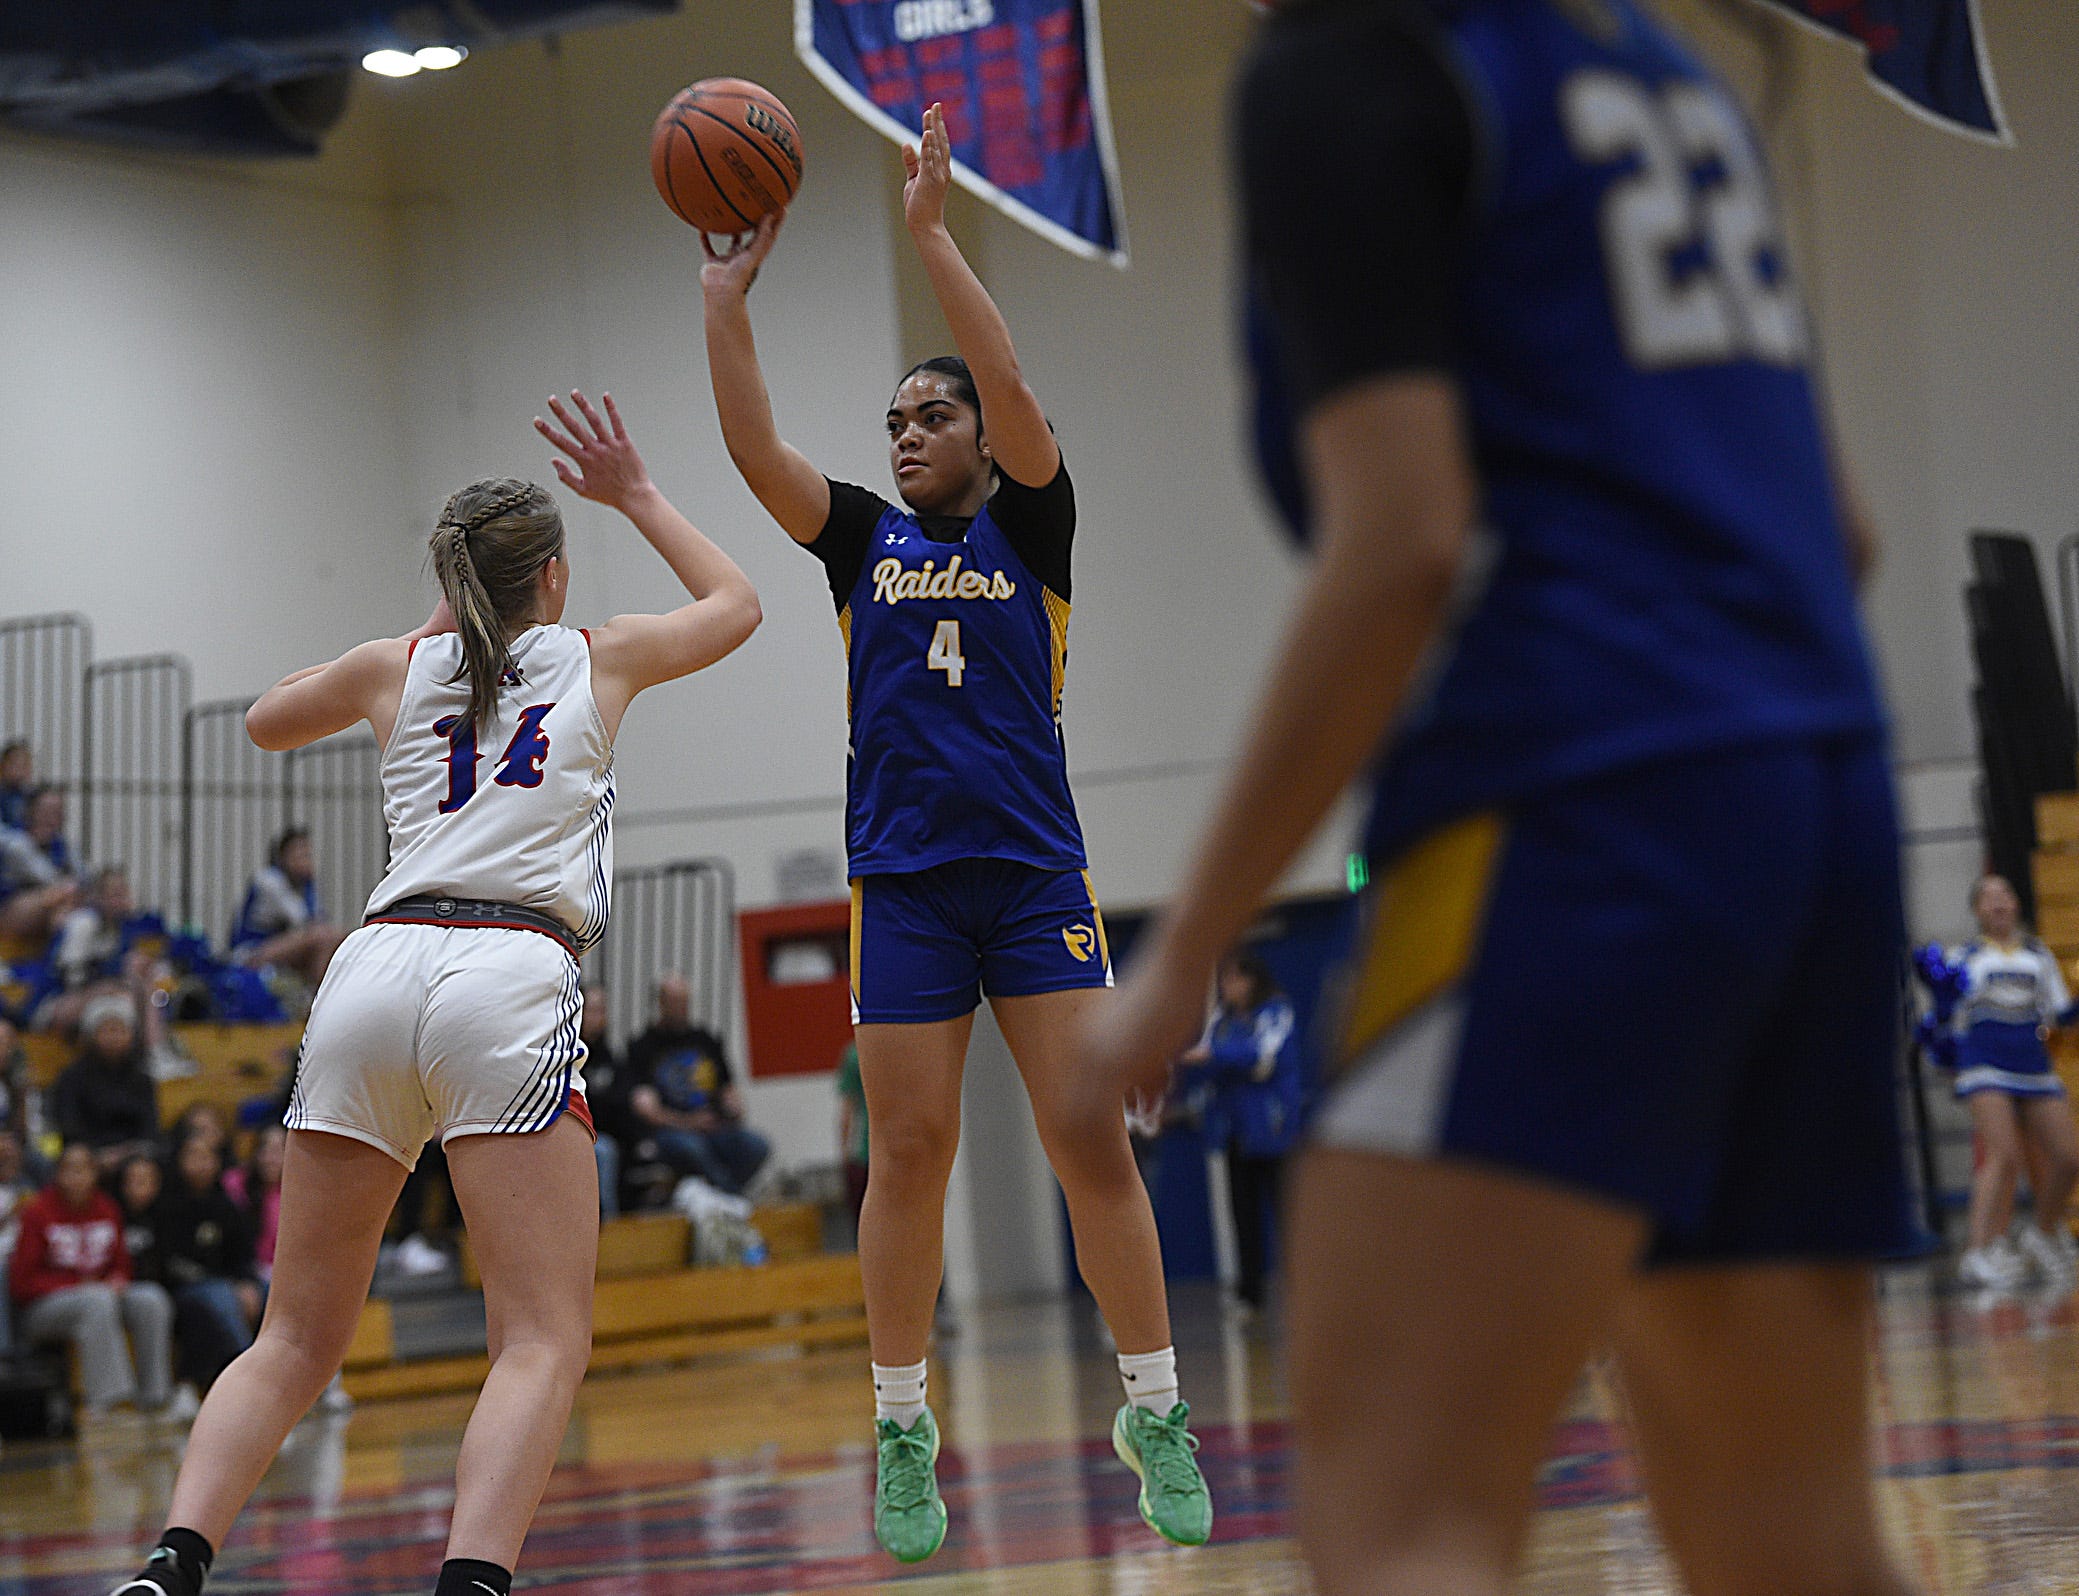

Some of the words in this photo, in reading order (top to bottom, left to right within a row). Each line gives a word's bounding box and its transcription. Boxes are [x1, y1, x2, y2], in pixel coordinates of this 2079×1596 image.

[894, 0, 994, 42] GIRLS
[873, 555, 1016, 605] Raiders
[927, 620, 966, 687] 4
[432, 702, 556, 815] 14
